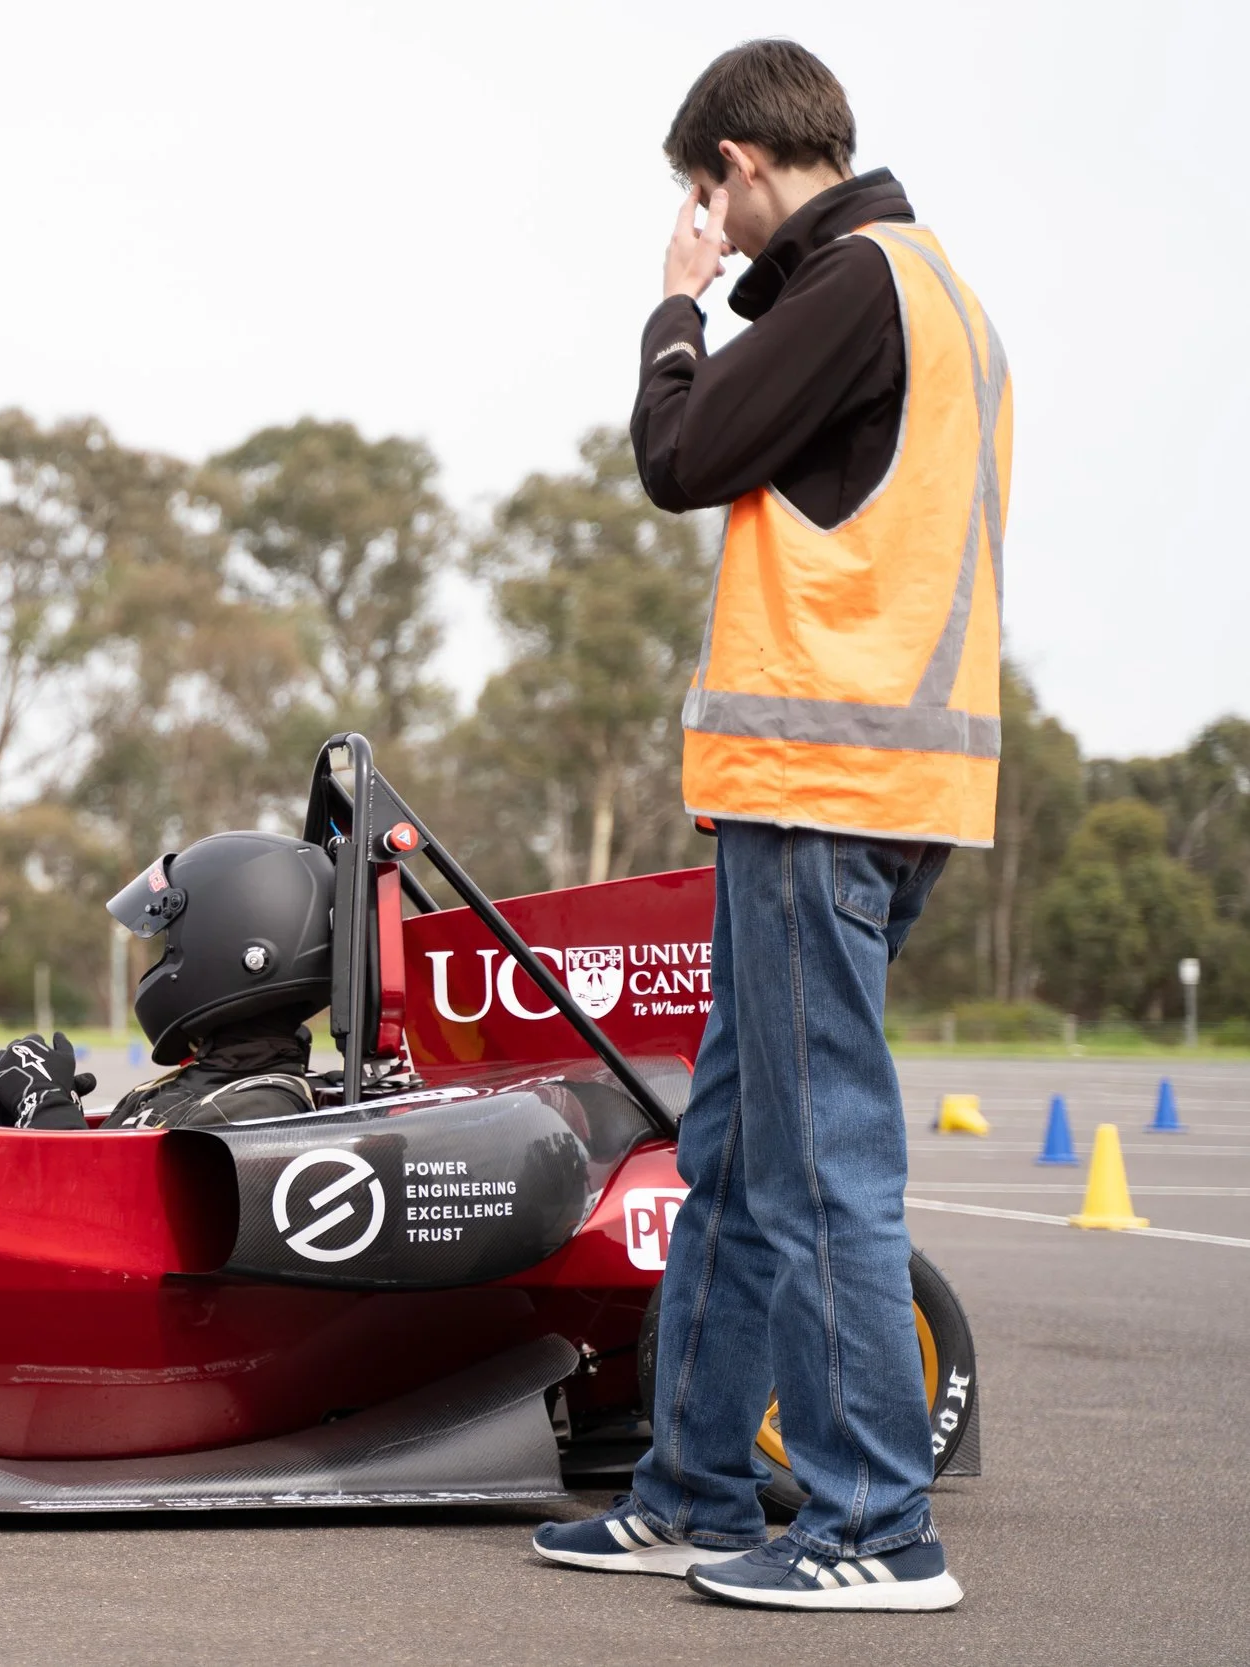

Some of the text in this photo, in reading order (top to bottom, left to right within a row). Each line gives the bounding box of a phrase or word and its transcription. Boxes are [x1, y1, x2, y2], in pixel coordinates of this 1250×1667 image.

[424, 946, 563, 1023] UC
[632, 1002, 648, 1016] Te
[651, 1000, 695, 1015] Whare
[404, 1161, 468, 1176] POWER
[406, 1181, 517, 1199] ENGINEERING
[406, 1202, 513, 1221] EXCELLENCE
[406, 1227, 463, 1243] TRUST
